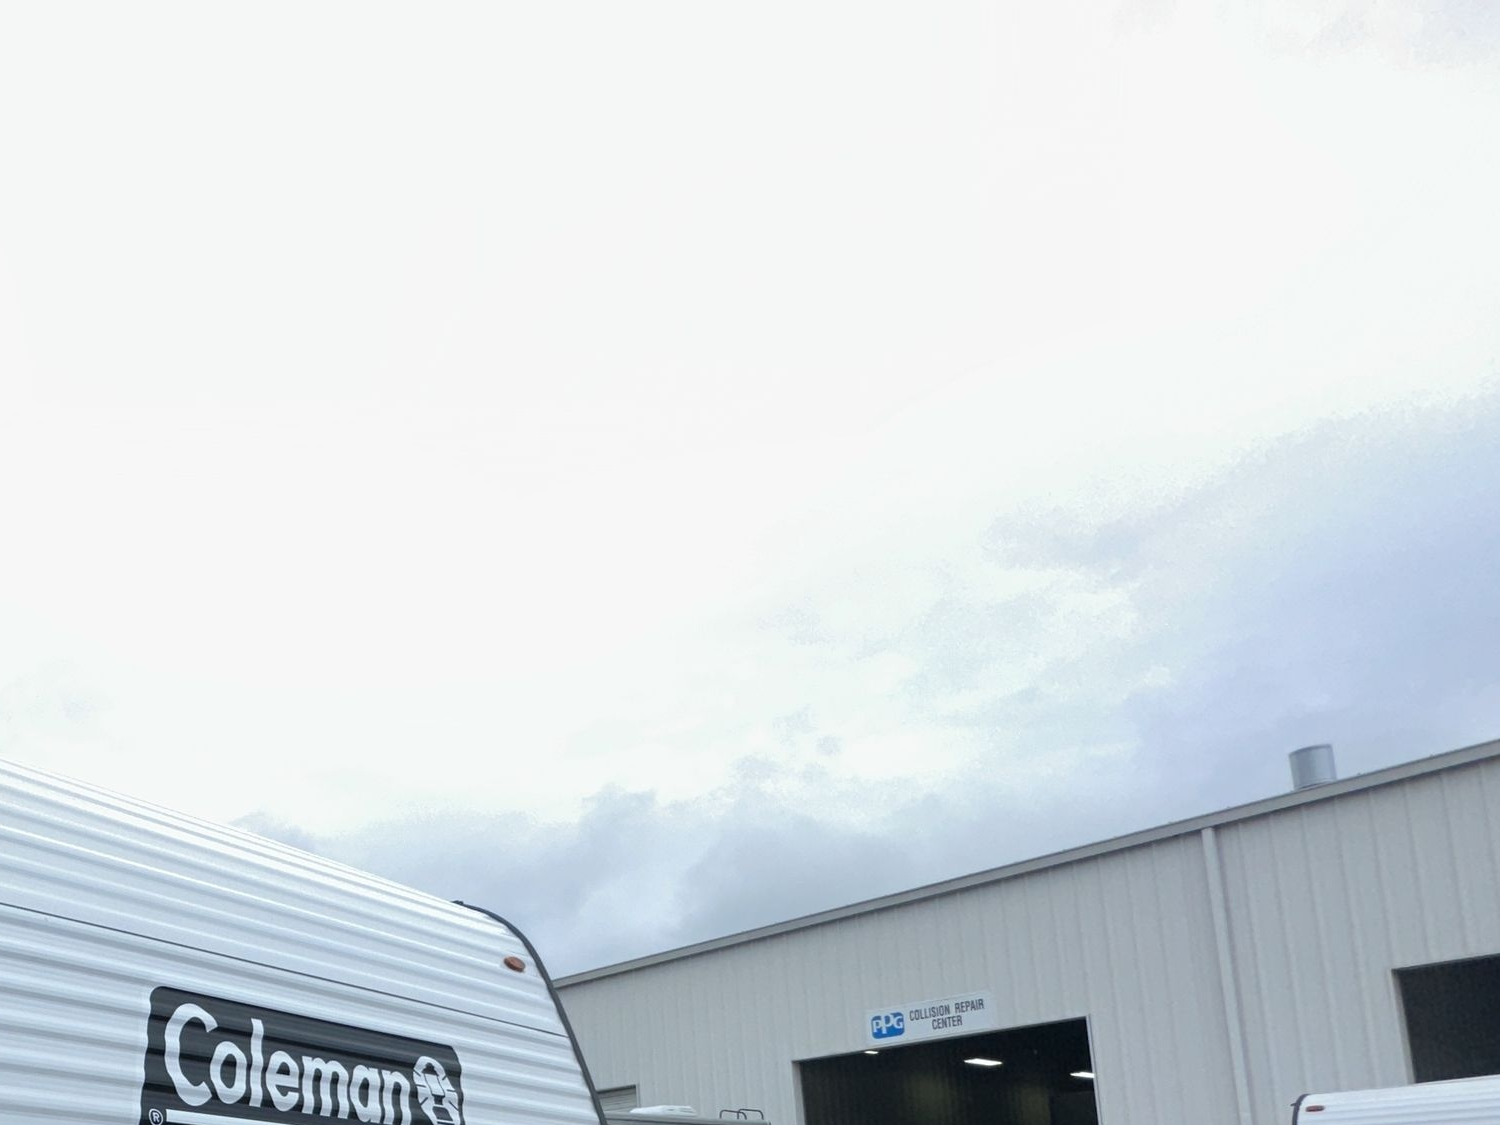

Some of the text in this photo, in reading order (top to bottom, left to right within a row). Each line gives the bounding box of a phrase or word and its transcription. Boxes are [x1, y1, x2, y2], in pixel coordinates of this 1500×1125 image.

[909, 998, 985, 1021] COLLISION REPAIR
[872, 1012, 904, 1036] PPG
[932, 1015, 963, 1030] CENTER
